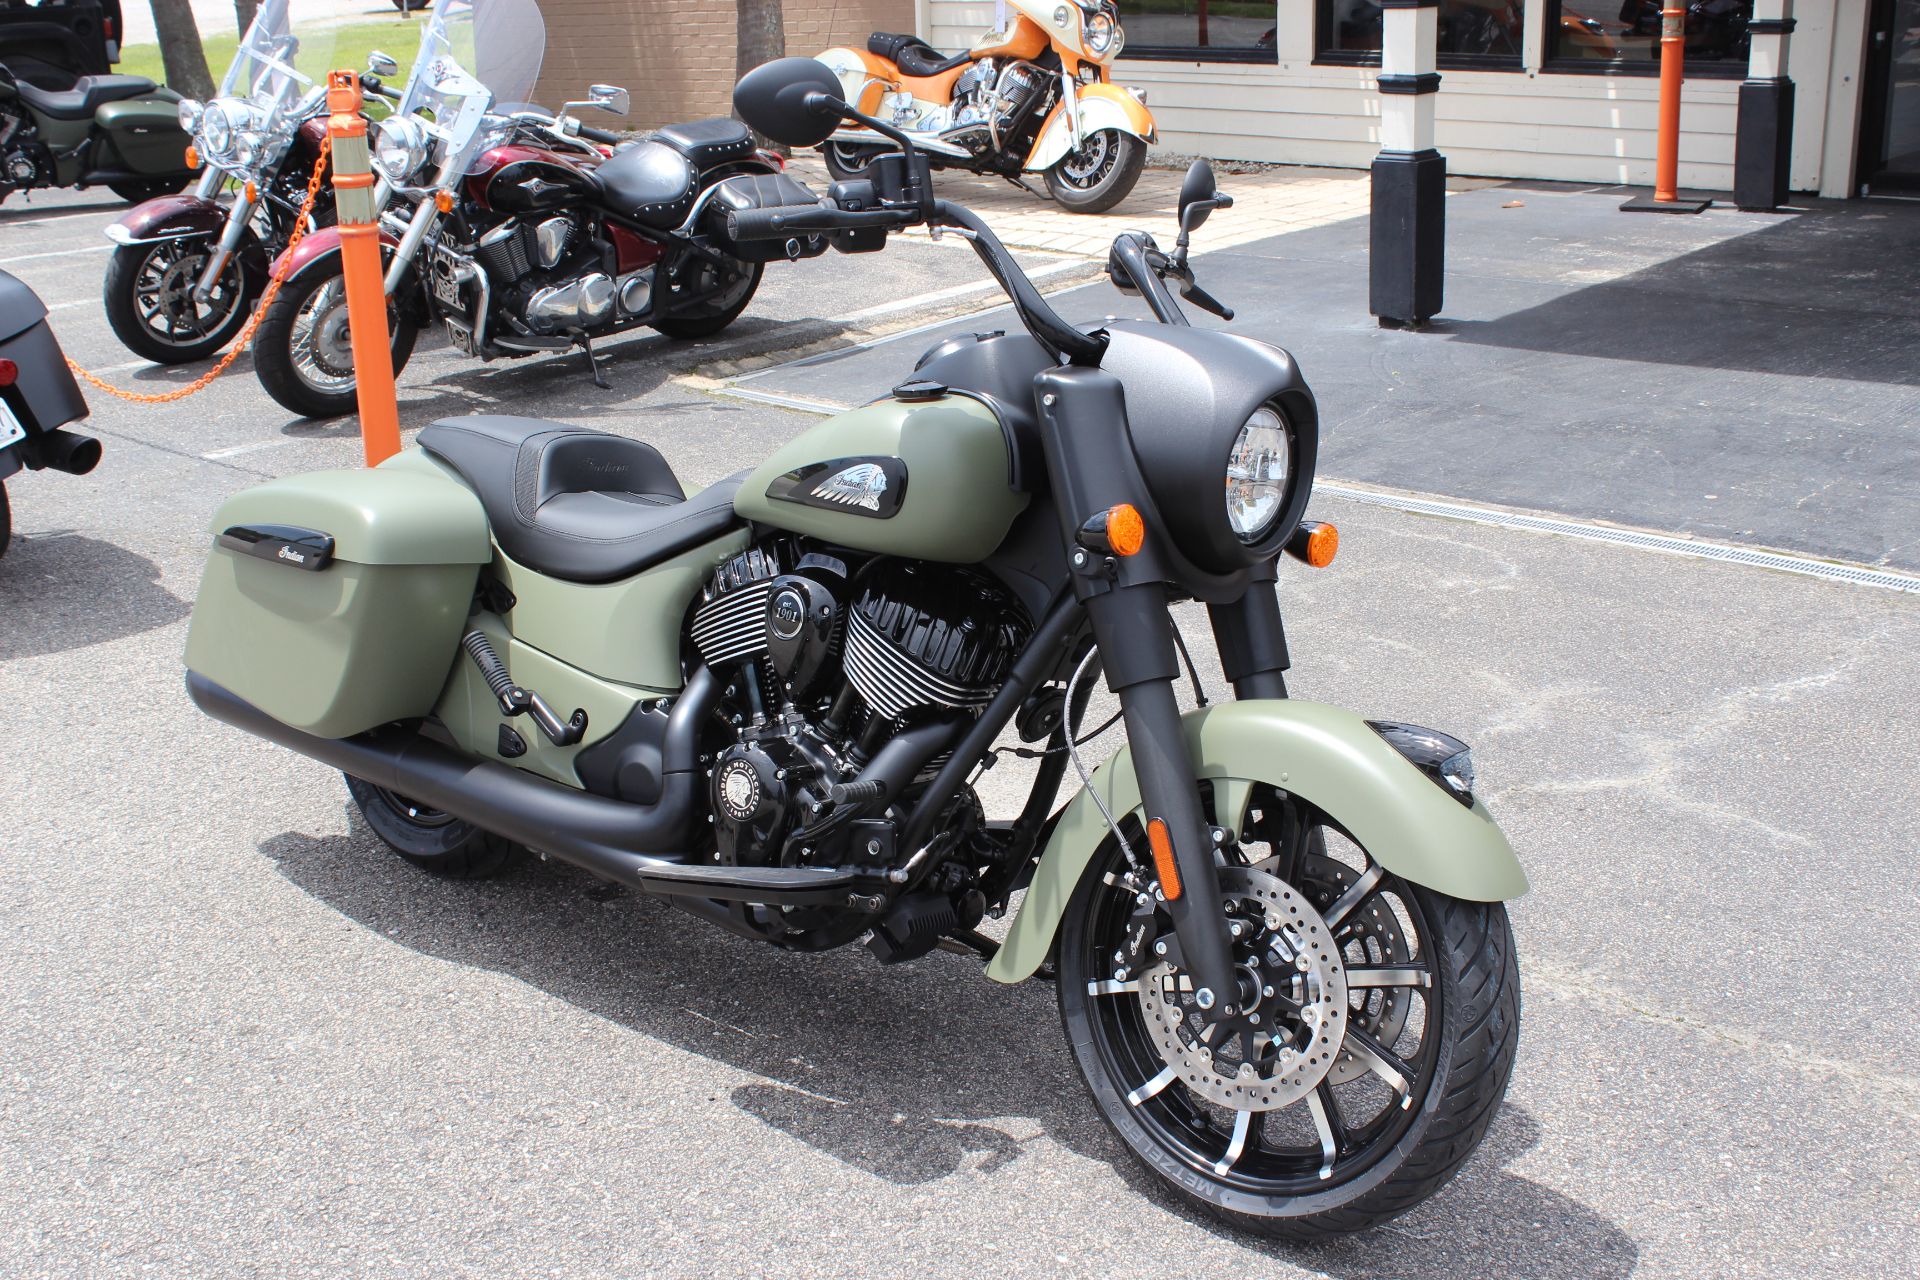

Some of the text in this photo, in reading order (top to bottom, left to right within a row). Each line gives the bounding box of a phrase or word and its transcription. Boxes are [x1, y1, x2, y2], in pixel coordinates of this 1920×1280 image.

[279, 546, 304, 563] Indian
[775, 607, 798, 623] 1901
[720, 761, 760, 812] INDIAN MOTORCYCLE
[1130, 923, 1146, 956] Indian
[1120, 1117, 1217, 1197] METZELER
